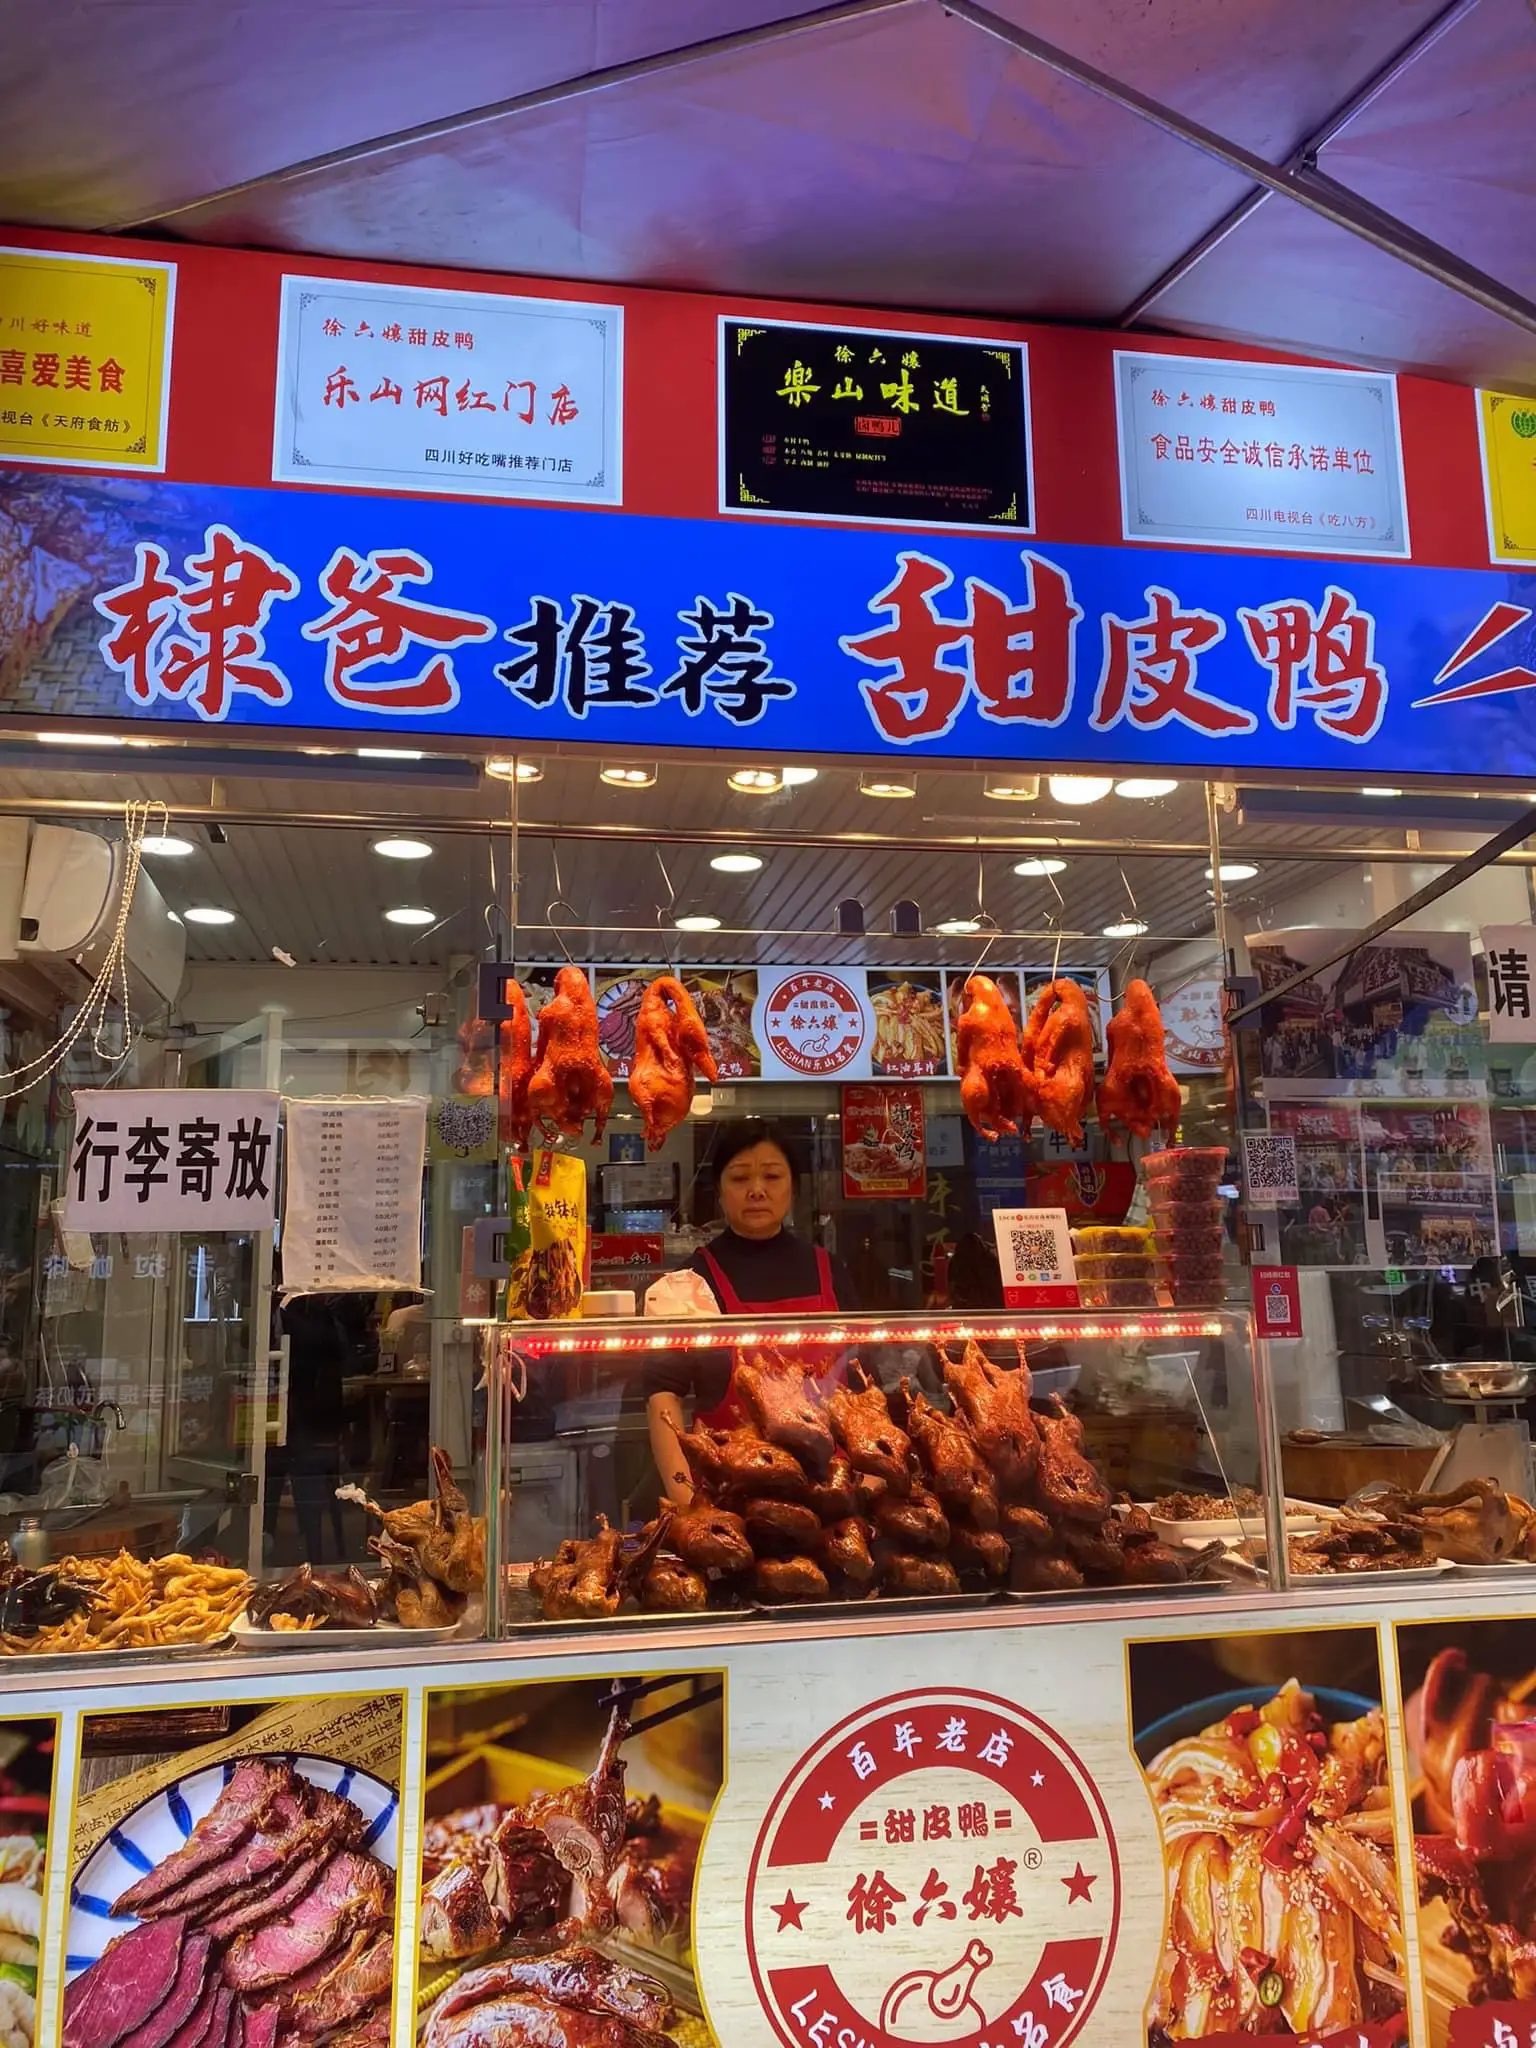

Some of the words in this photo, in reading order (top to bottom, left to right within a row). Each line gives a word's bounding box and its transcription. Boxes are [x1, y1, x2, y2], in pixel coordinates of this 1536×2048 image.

[0, 317, 93, 338] 川好味道
[0, 348, 125, 395] 喜爱美食
[323, 365, 580, 426] 乐山网红门店
[425, 448, 573, 472] 四川好吃嘴推荐门店
[1151, 432, 1374, 475] 食品安全诚信承诺单位
[1246, 508, 1377, 529] 四川电视台《吃八方》
[841, 550, 1388, 744] 甜皮鸭
[1489, 947, 1531, 1020] 请
[74, 1116, 272, 1203] 行李寄放
[847, 1716, 1015, 1780] 百年老店
